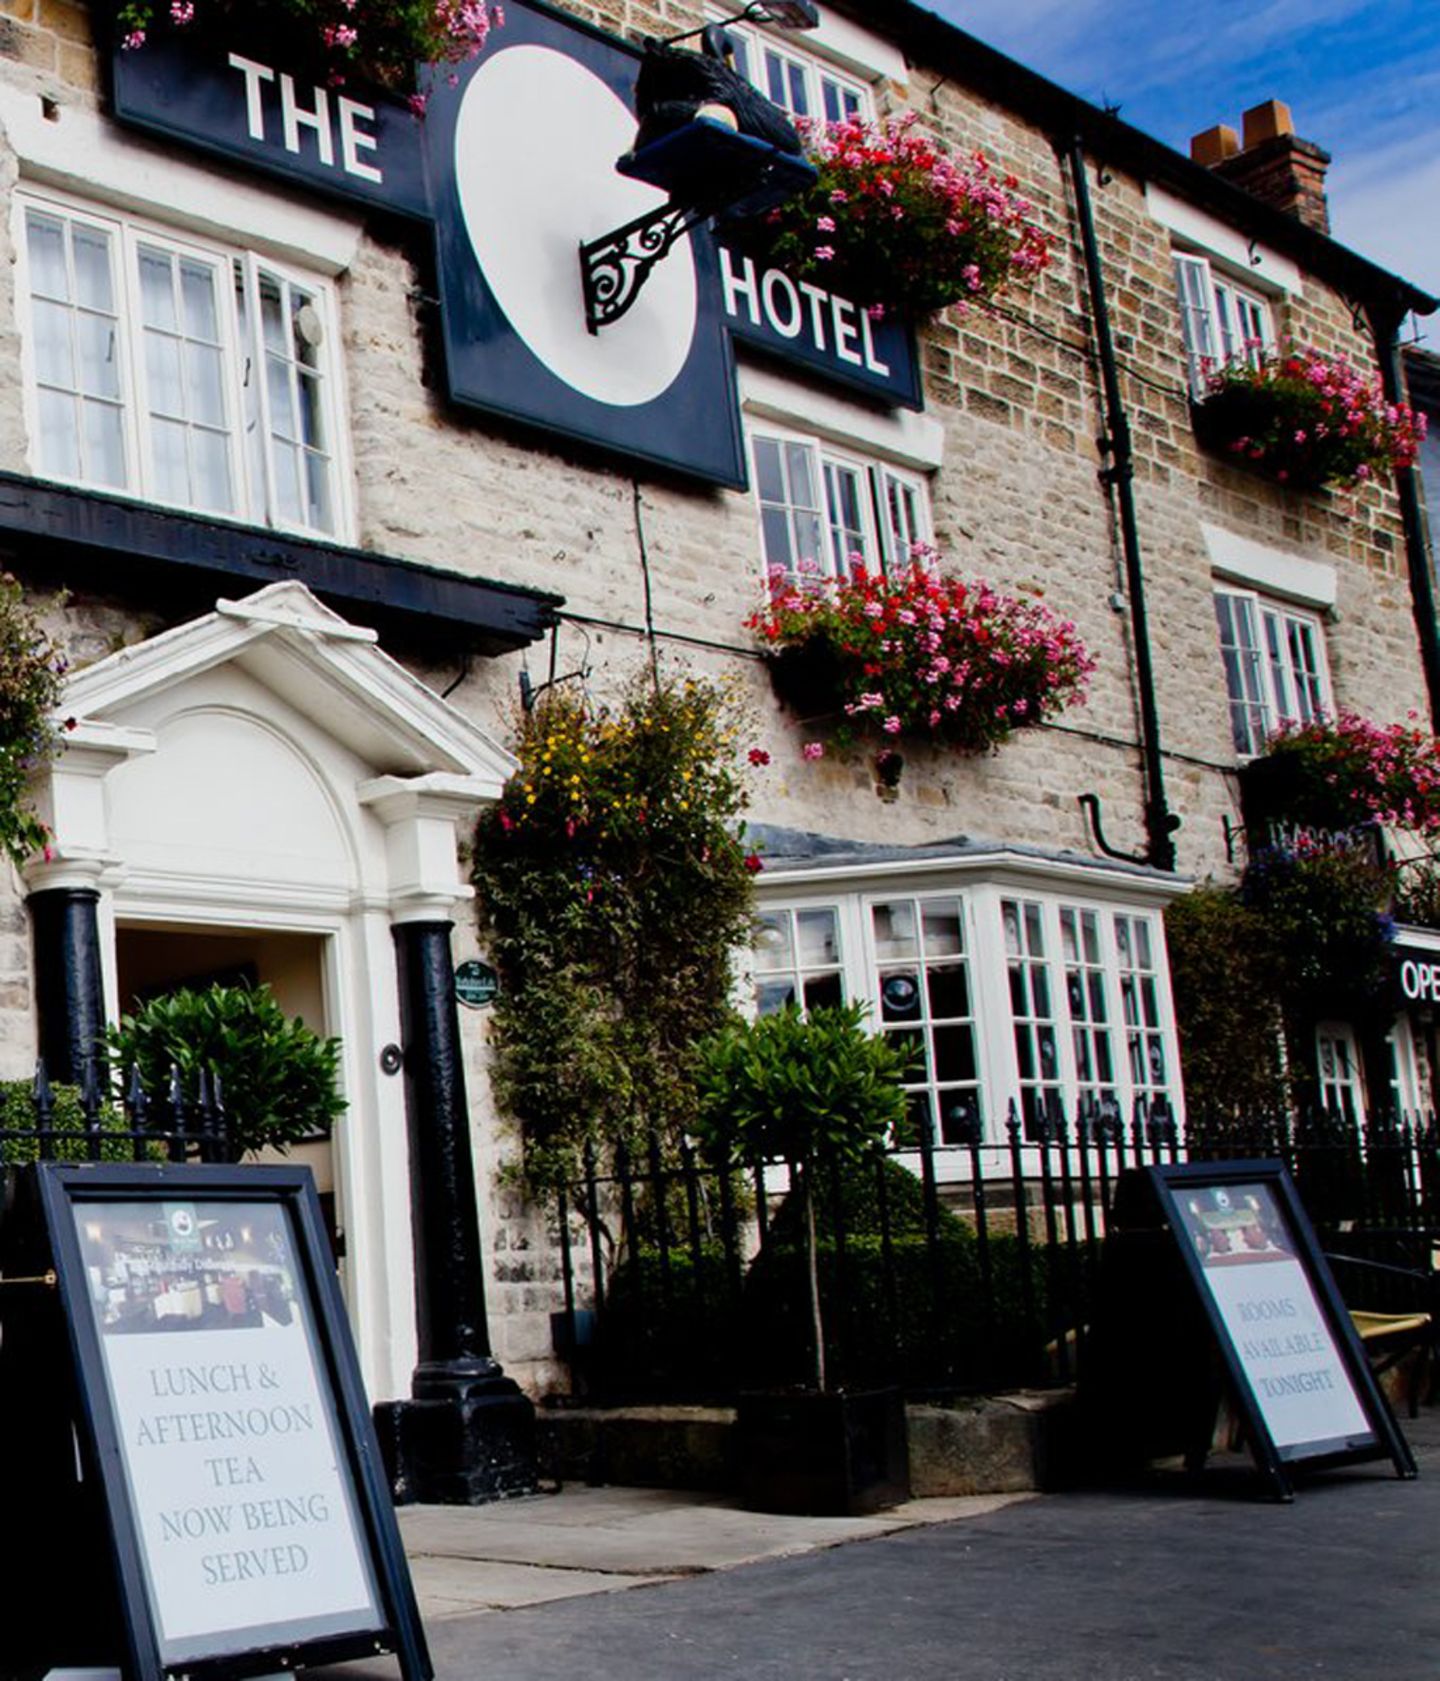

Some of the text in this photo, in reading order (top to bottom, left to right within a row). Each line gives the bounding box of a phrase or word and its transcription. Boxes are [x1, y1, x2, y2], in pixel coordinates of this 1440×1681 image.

[228, 52, 890, 377] THE HOTEL
[1236, 1298, 1297, 1323] ROOMS
[1241, 1332, 1326, 1361] AVAILABLE
[150, 1363, 280, 1397] LUNCH &
[1258, 1369, 1335, 1398] TONIGHT
[136, 1403, 314, 1446] AFTERNOON
[204, 1456, 265, 1487] TEA
[159, 1494, 330, 1541] NOW BEING
[201, 1544, 309, 1586] SERVED
